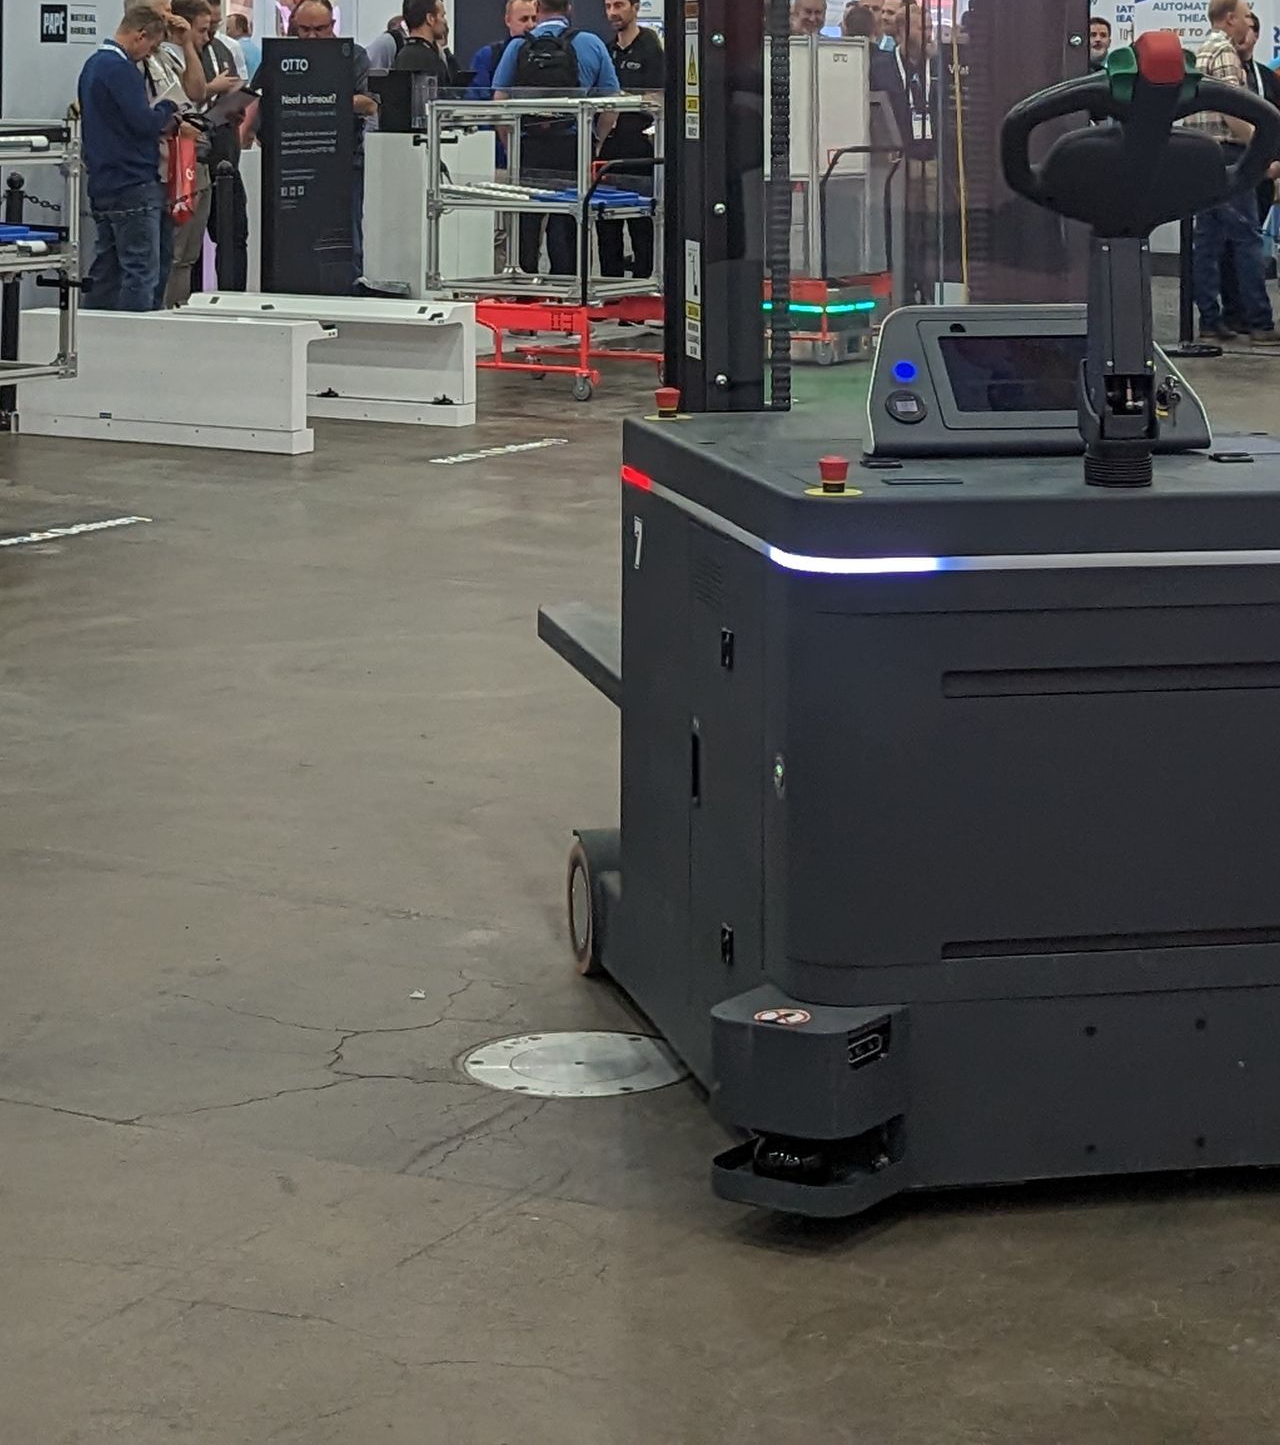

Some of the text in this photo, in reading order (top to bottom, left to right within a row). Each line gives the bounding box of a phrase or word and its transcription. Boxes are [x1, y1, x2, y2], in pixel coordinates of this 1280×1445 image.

[281, 59, 309, 72] OTTO
[281, 93, 337, 105] Need a timeout?
